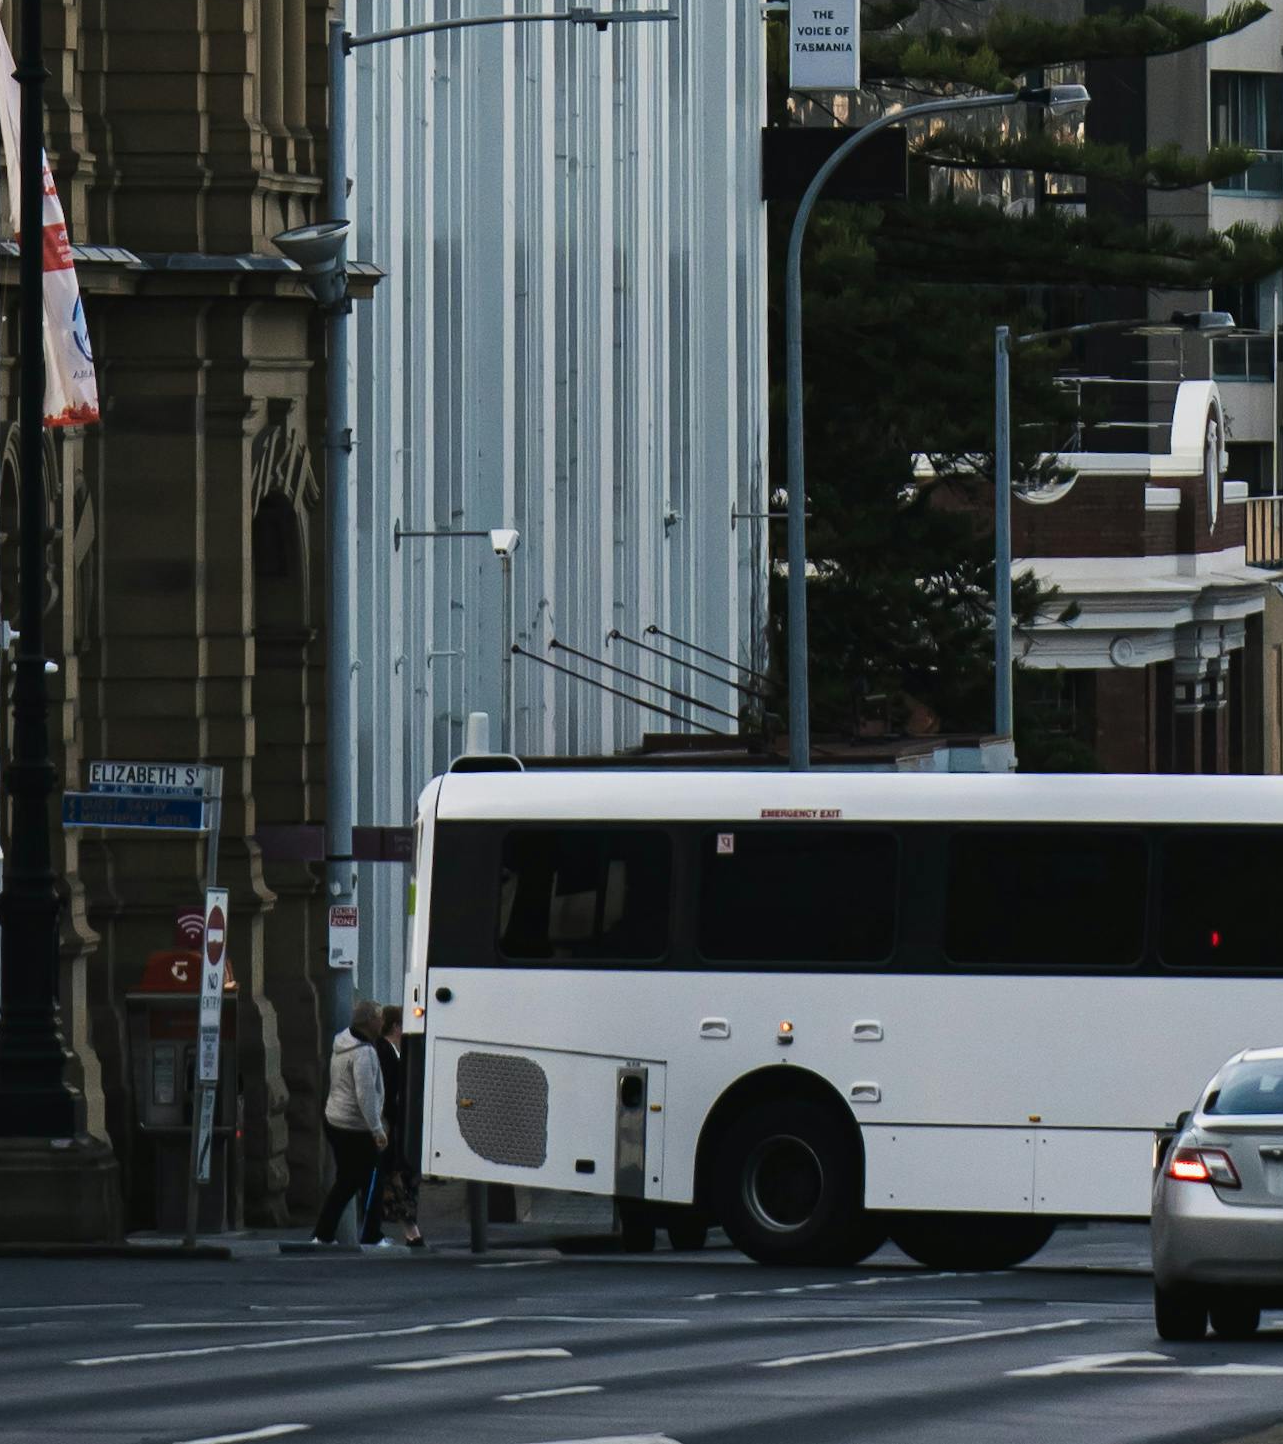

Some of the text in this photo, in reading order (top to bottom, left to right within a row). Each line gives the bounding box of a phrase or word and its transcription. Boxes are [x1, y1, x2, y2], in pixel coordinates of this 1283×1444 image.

[812, 10, 835, 20] THE
[797, 26, 850, 36] VOICE OF
[794, 42, 853, 52] TASMANIA
[91, 764, 176, 785] ELIZABETH
[761, 809, 841, 818] EMERGENCY EXIT
[331, 918, 356, 926] ZONE
[207, 973, 219, 989] NO
[202, 996, 221, 1010] ENTRY
